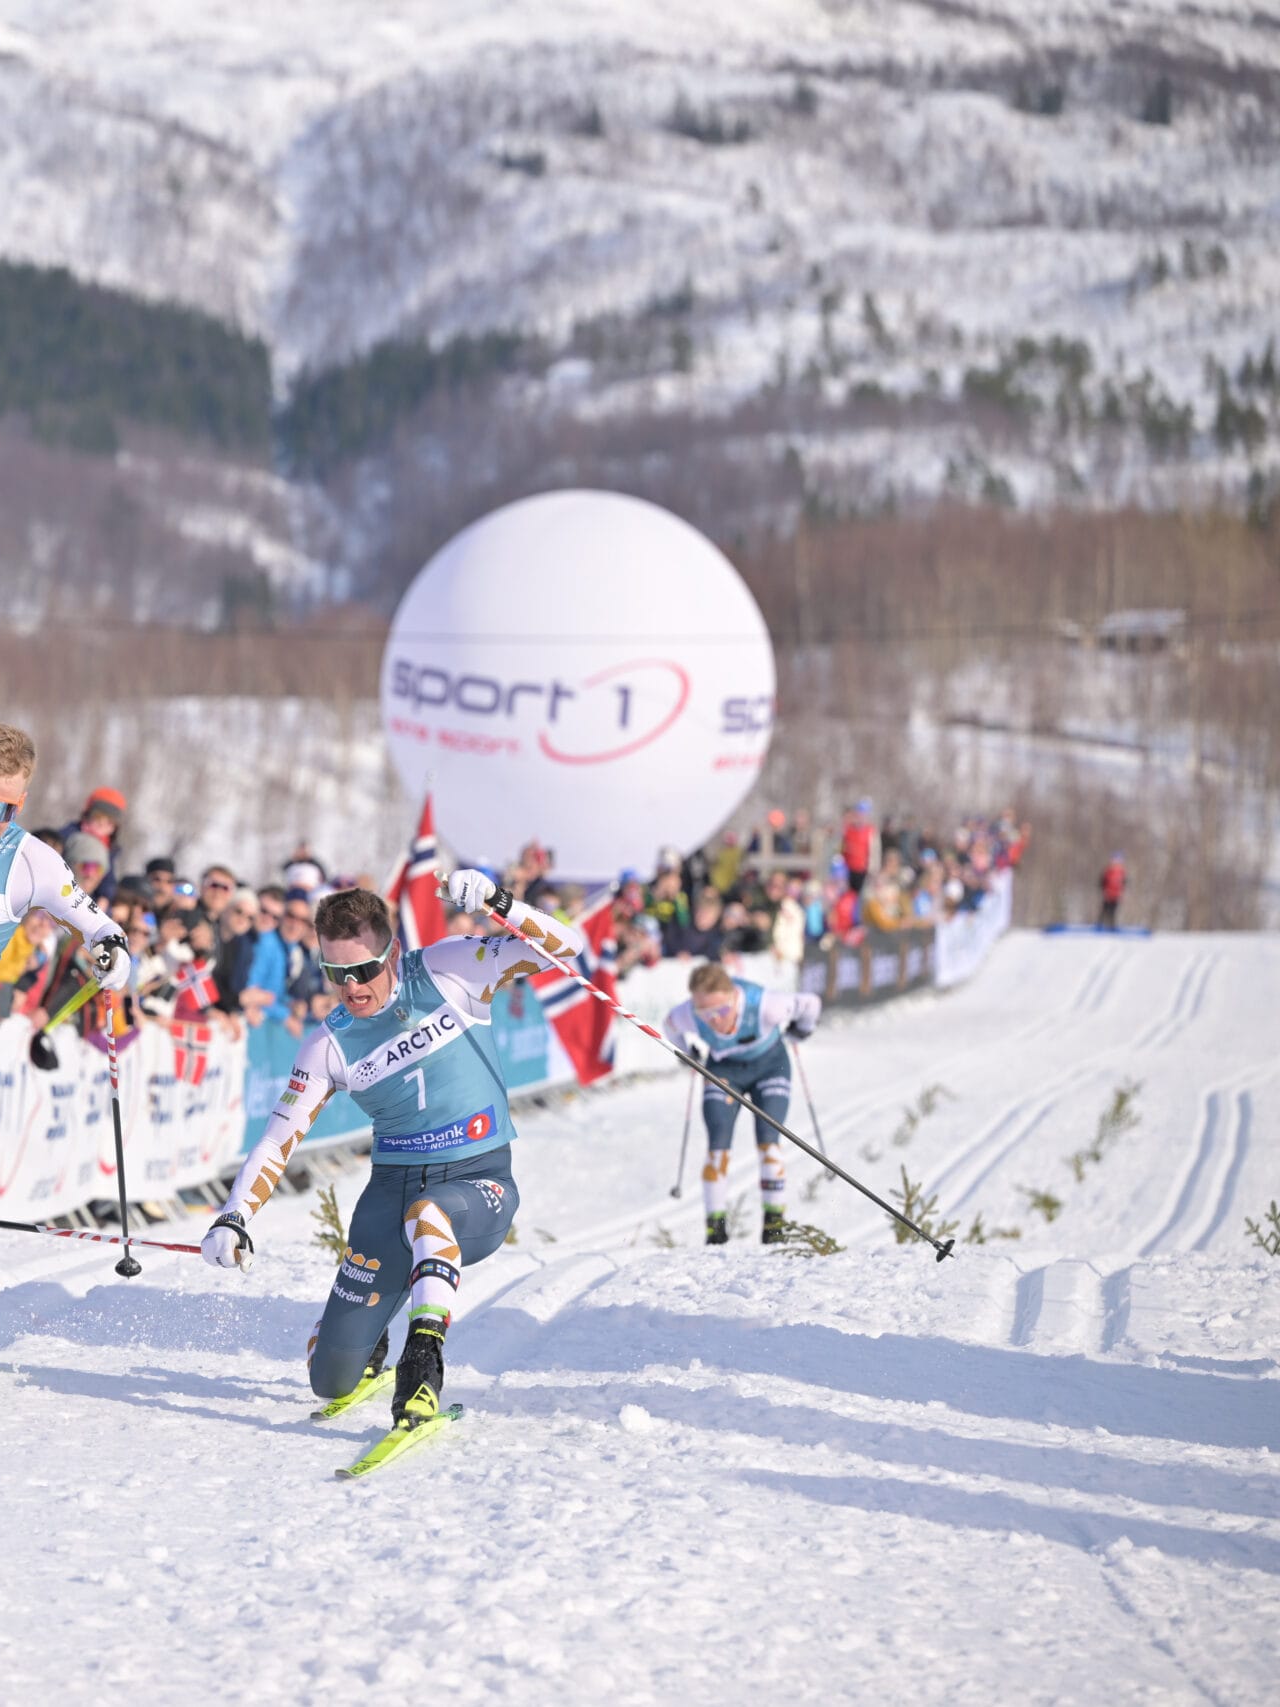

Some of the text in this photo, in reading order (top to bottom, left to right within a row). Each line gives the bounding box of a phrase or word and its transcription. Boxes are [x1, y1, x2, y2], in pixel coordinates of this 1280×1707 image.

[391, 660, 633, 730] sport 1
[386, 1014, 456, 1067] ARCTIC
[403, 1068, 426, 1111] 7
[473, 1118, 483, 1135] 1
